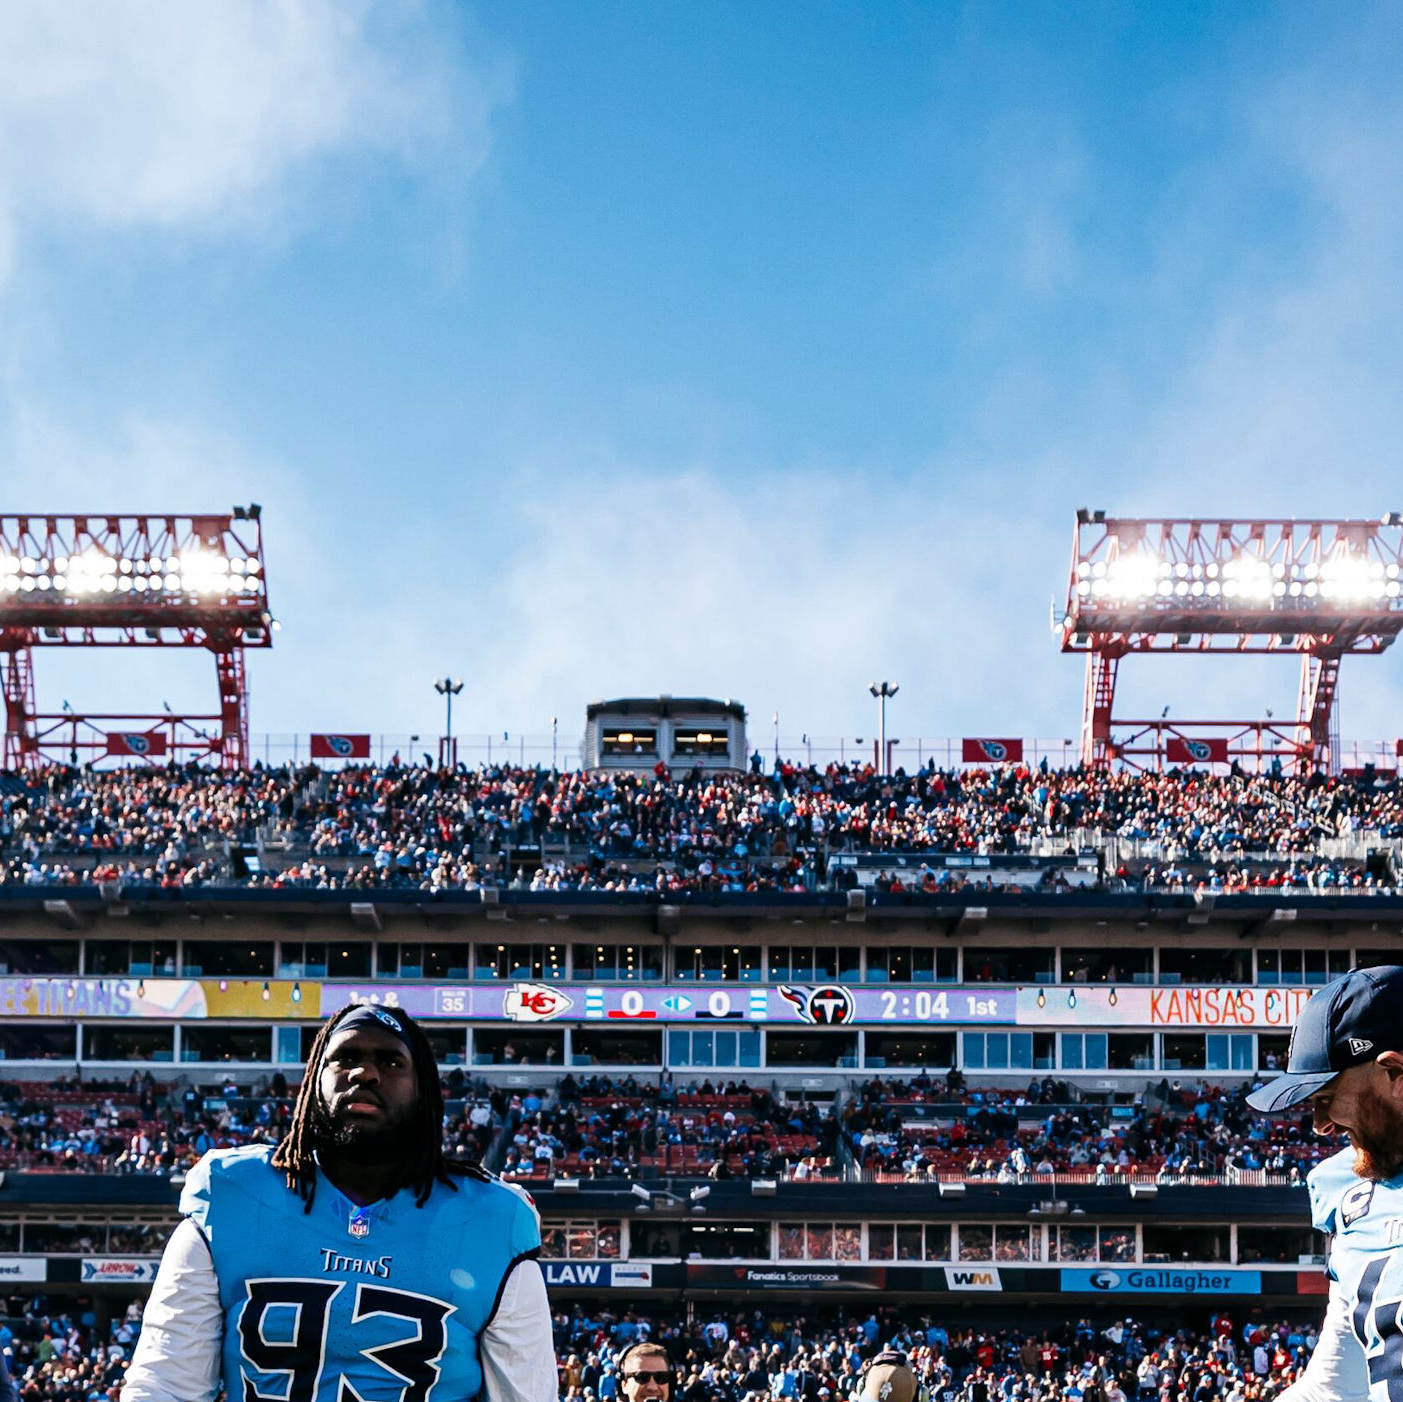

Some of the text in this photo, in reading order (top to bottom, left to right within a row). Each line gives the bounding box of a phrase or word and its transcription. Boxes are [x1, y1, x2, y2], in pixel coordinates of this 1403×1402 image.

[35, 978, 132, 1015] TITANS
[620, 990, 644, 1017] 0
[708, 990, 731, 1018] 0
[880, 990, 998, 1020] 2:04 1st
[1149, 988, 1315, 1025] KANSAS CIT
[546, 1264, 601, 1284] LAW
[747, 1270, 840, 1283] Fanatics Sportsbook
[953, 1272, 994, 1285] WM
[1127, 1270, 1232, 1292] Gallagher
